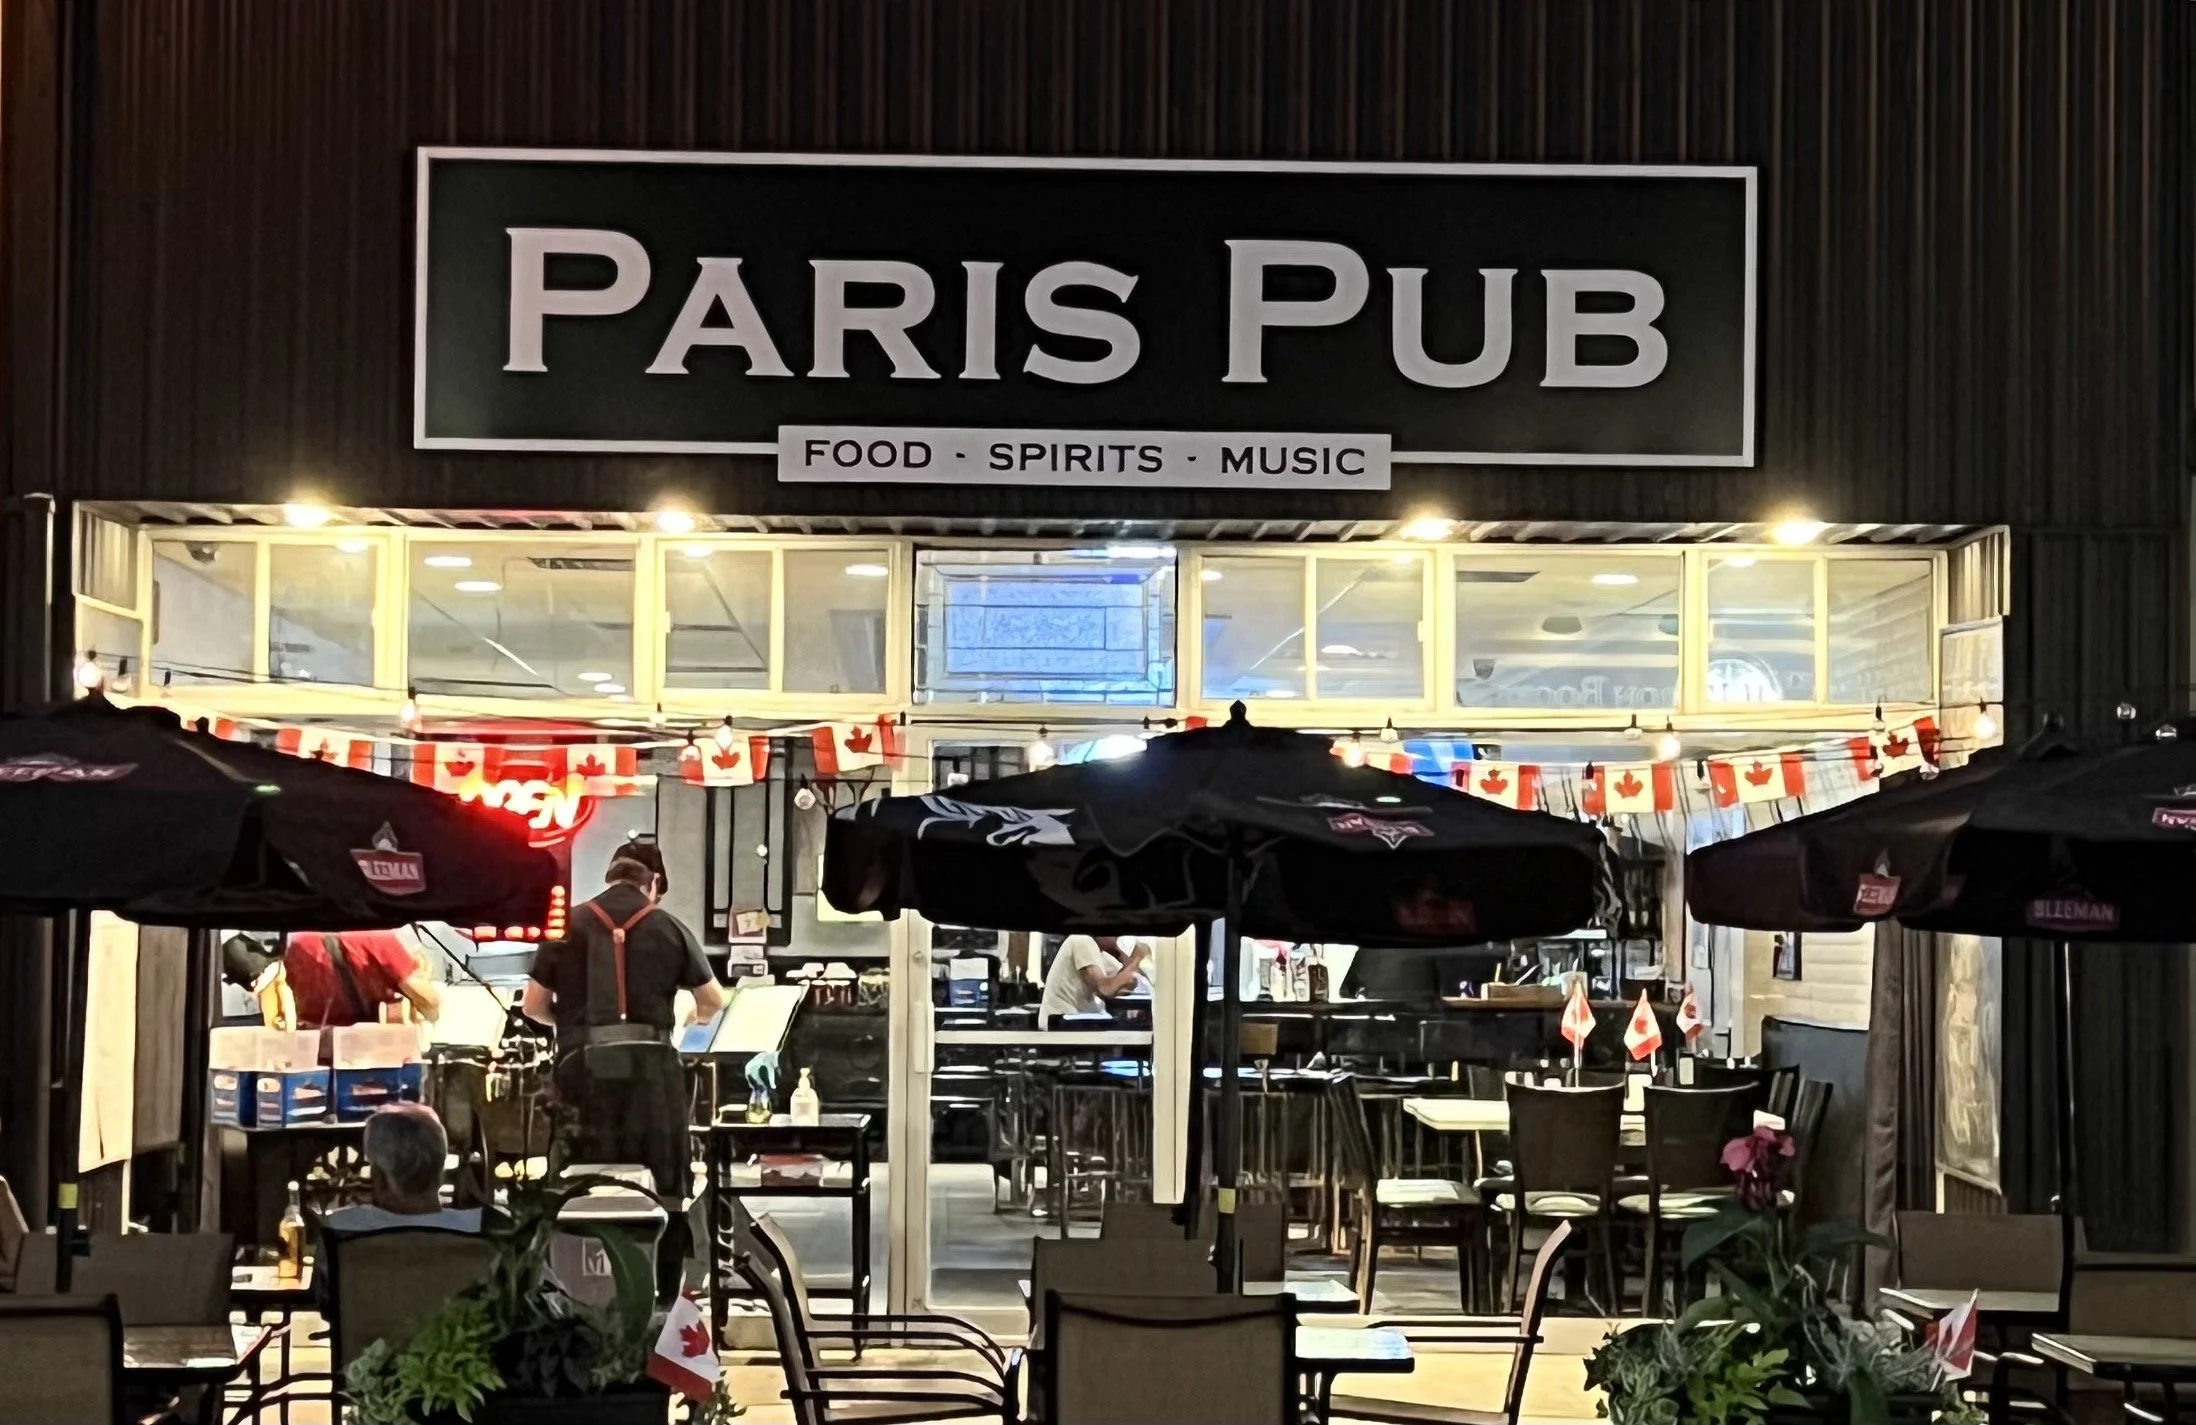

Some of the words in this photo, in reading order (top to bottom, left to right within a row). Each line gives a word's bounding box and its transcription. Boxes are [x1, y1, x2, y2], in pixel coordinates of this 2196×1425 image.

[503, 228, 1140, 383] PARIS
[1222, 240, 1667, 388] PUB
[805, 440, 931, 468] FOOD
[990, 443, 1162, 473] SPIRITS
[1222, 447, 1365, 475] MUSIC
